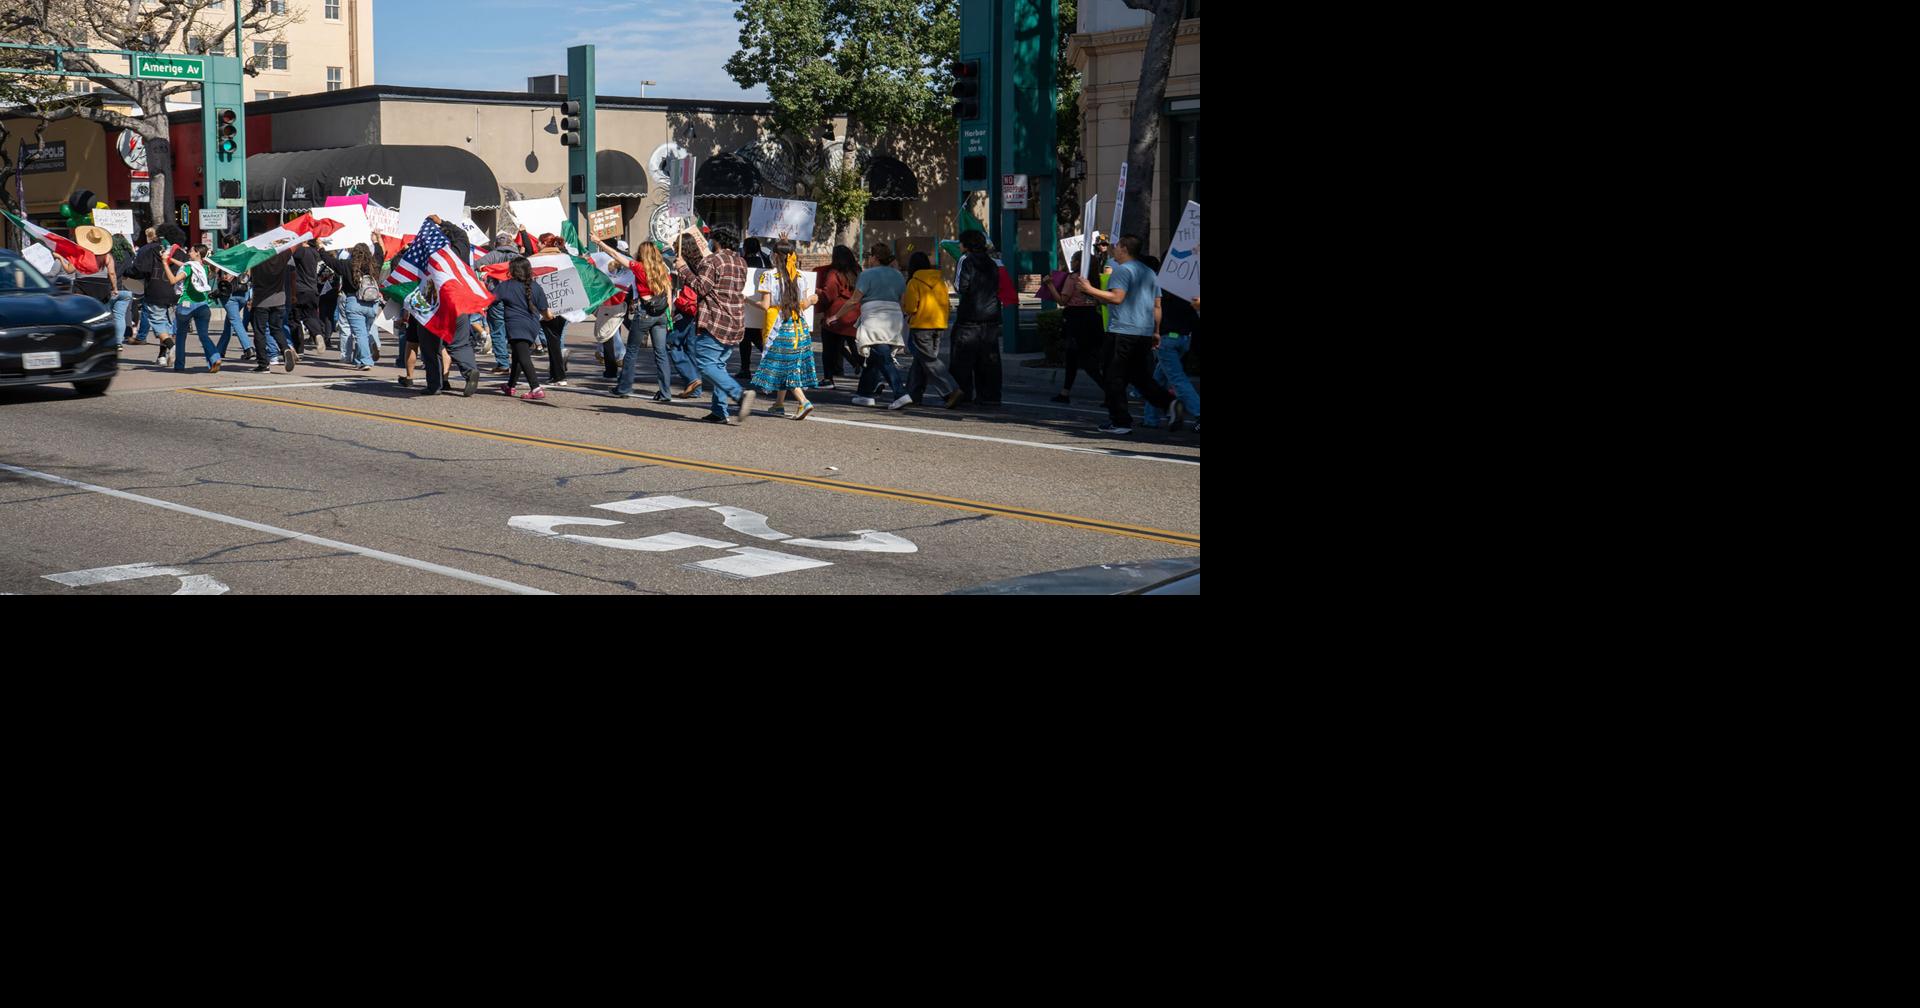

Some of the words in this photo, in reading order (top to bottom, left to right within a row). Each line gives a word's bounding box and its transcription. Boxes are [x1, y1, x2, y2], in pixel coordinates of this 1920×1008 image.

[142, 62, 183, 75] Amerige
[186, 65, 200, 74] Av
[964, 129, 987, 137] Harbor
[340, 175, 366, 187] Night
[1003, 176, 1014, 185] NO
[550, 278, 570, 290] THE
